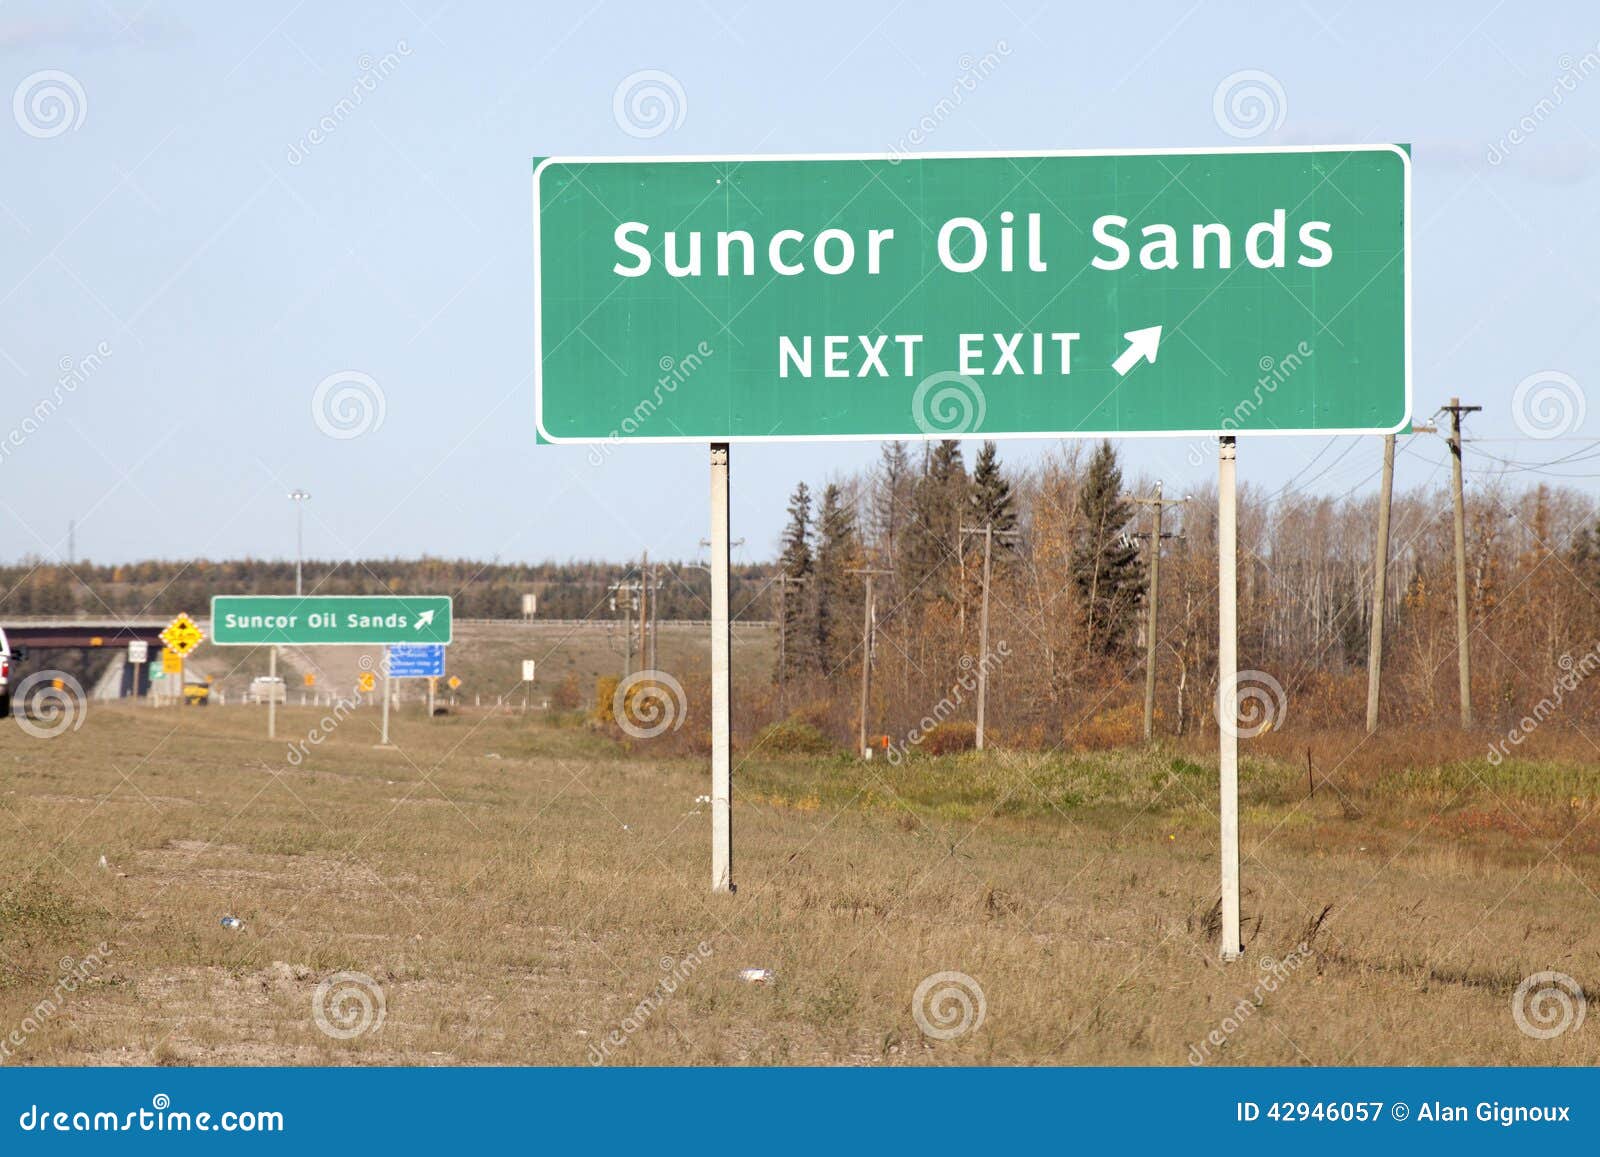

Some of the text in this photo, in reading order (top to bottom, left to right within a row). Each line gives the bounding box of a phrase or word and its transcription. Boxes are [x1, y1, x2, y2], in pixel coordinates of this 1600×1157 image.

[613, 208, 1333, 278] Suncor Oil Sands
[779, 332, 1080, 379] NEXT EXIT
[225, 612, 408, 628] Suncor Oil Sands
